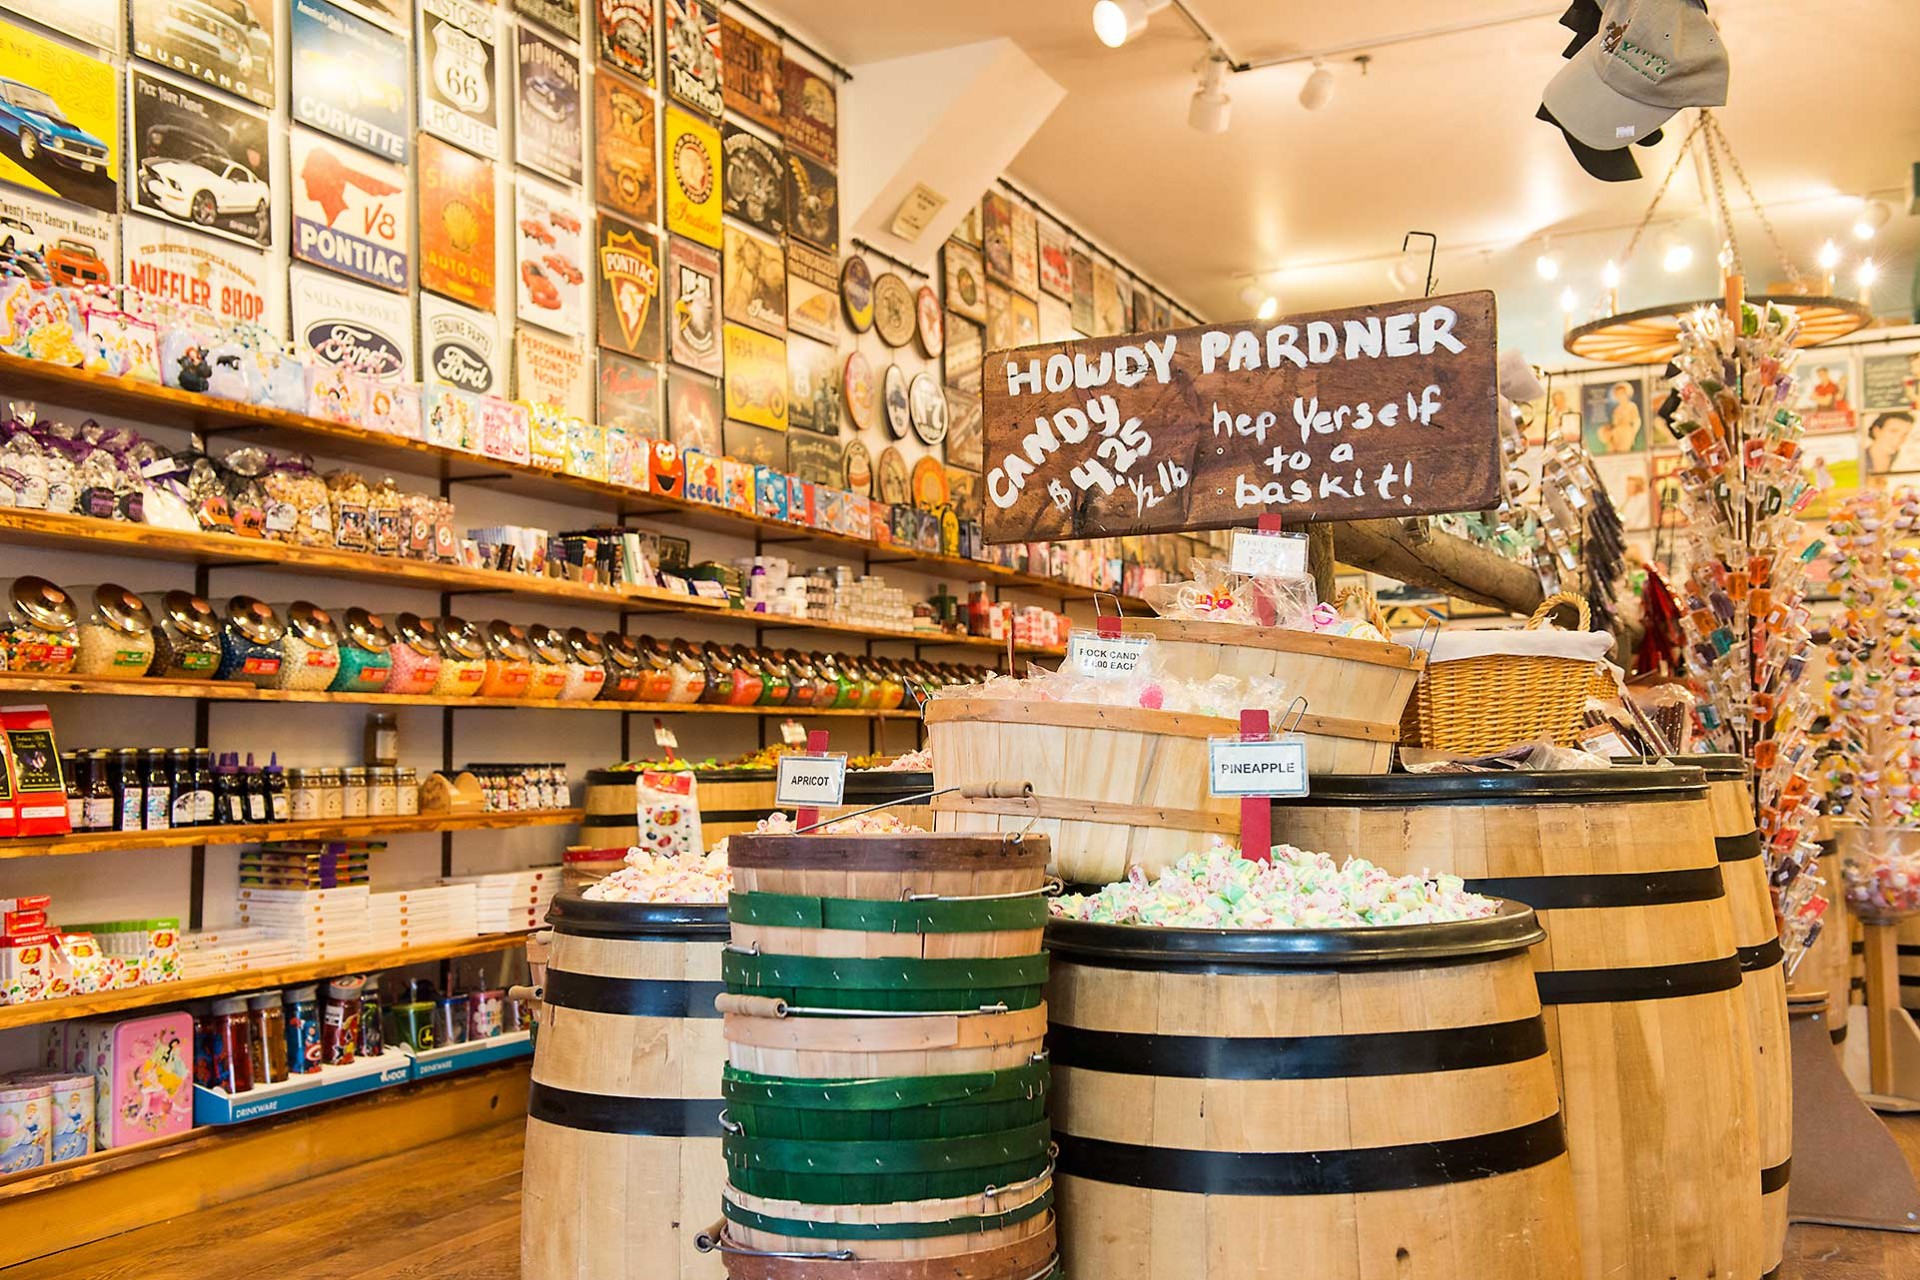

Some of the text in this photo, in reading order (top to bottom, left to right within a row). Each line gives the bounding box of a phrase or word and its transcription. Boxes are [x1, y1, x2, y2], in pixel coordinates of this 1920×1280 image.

[137, 41, 249, 94] MUSTANG
[446, 66, 478, 104] 66
[300, 96, 404, 158] CORVETTE
[432, 105, 496, 150] ROUTE
[426, 167, 492, 216] SHELL
[363, 203, 397, 241] V8
[301, 222, 404, 284] PONTIAC
[428, 251, 492, 288] AUTO OIL
[606, 252, 654, 286] PONTIAC
[130, 259, 264, 321] MUFFLER SHOP
[437, 346, 488, 389] Ford
[521, 333, 582, 366] PERFORMANCE
[1006, 305, 1466, 396] HOWDY PARDNER
[1212, 384, 1442, 446] hep Yerself
[987, 395, 1121, 509] CANDY
[1264, 443, 1355, 475] to a
[1234, 459, 1414, 510] baskit!
[790, 774, 830, 788] APRICOT
[1221, 761, 1296, 778] PINEAPPLE
[419, 1060, 453, 1076] DRINKWARE
[235, 1100, 278, 1119] DRINKWARE
